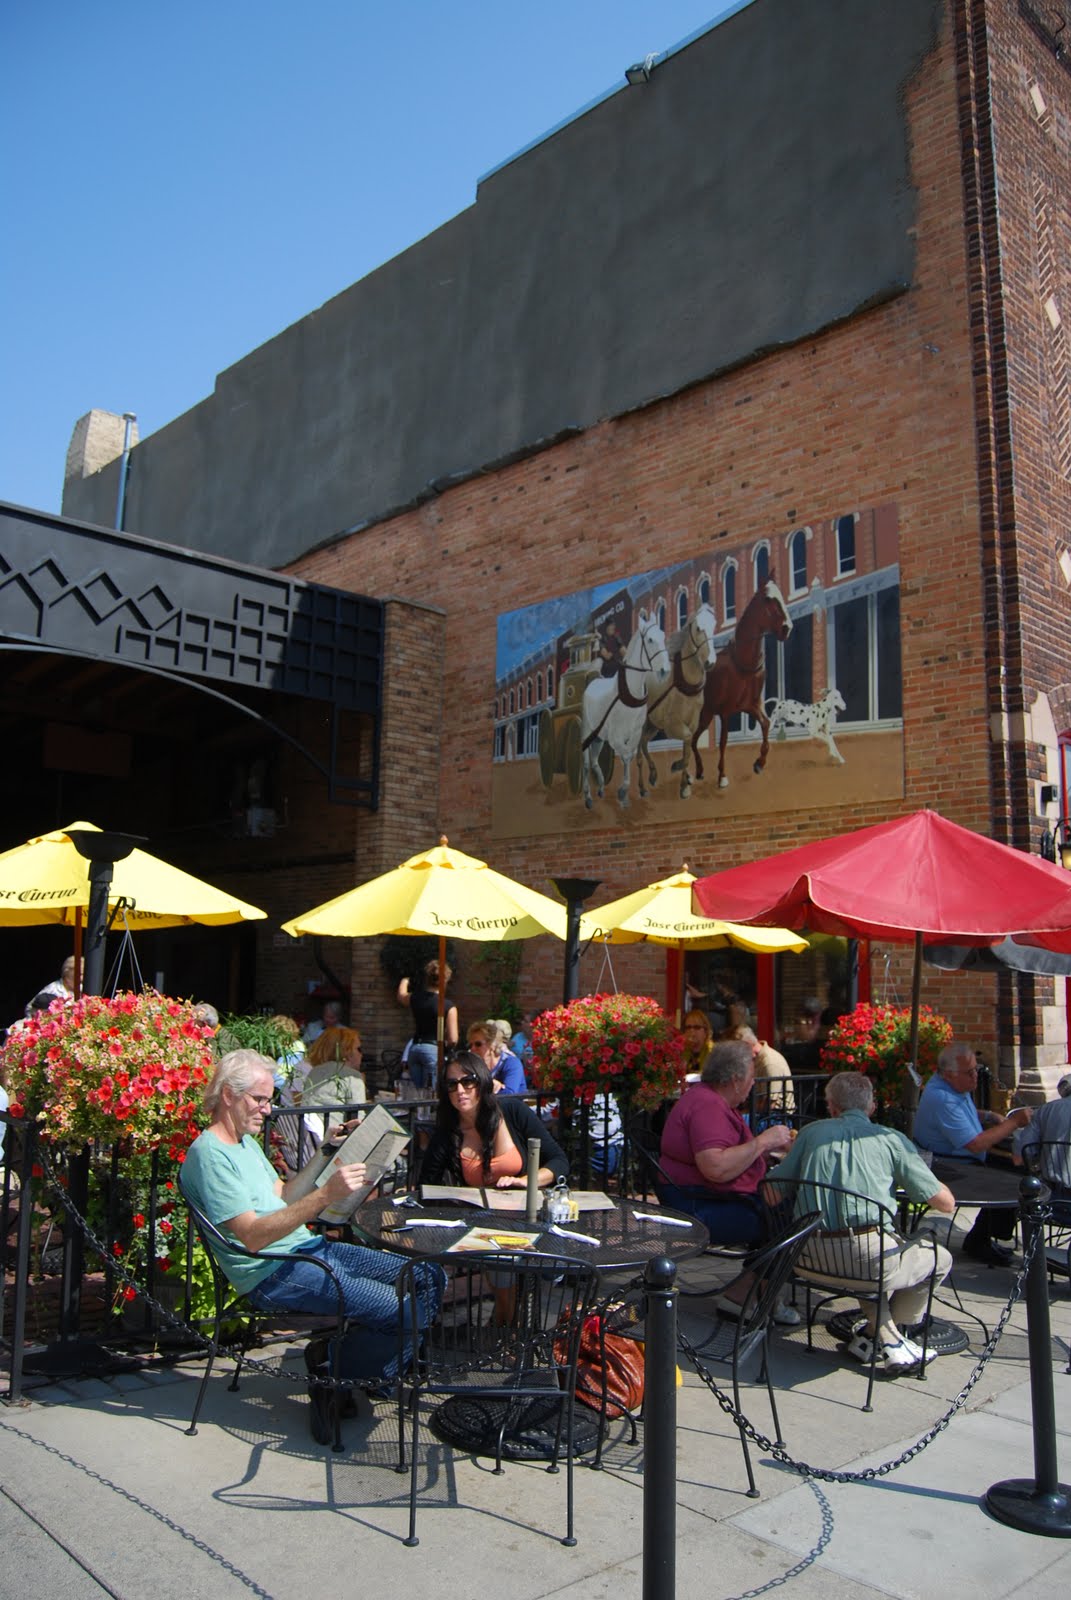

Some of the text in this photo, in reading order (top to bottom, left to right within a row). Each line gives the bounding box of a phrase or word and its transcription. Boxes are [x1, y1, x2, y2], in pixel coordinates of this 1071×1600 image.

[18, 888, 77, 903] Cuervo
[429, 911, 518, 931] Jose Cuervo
[643, 917, 715, 932] Jose Cuervo
